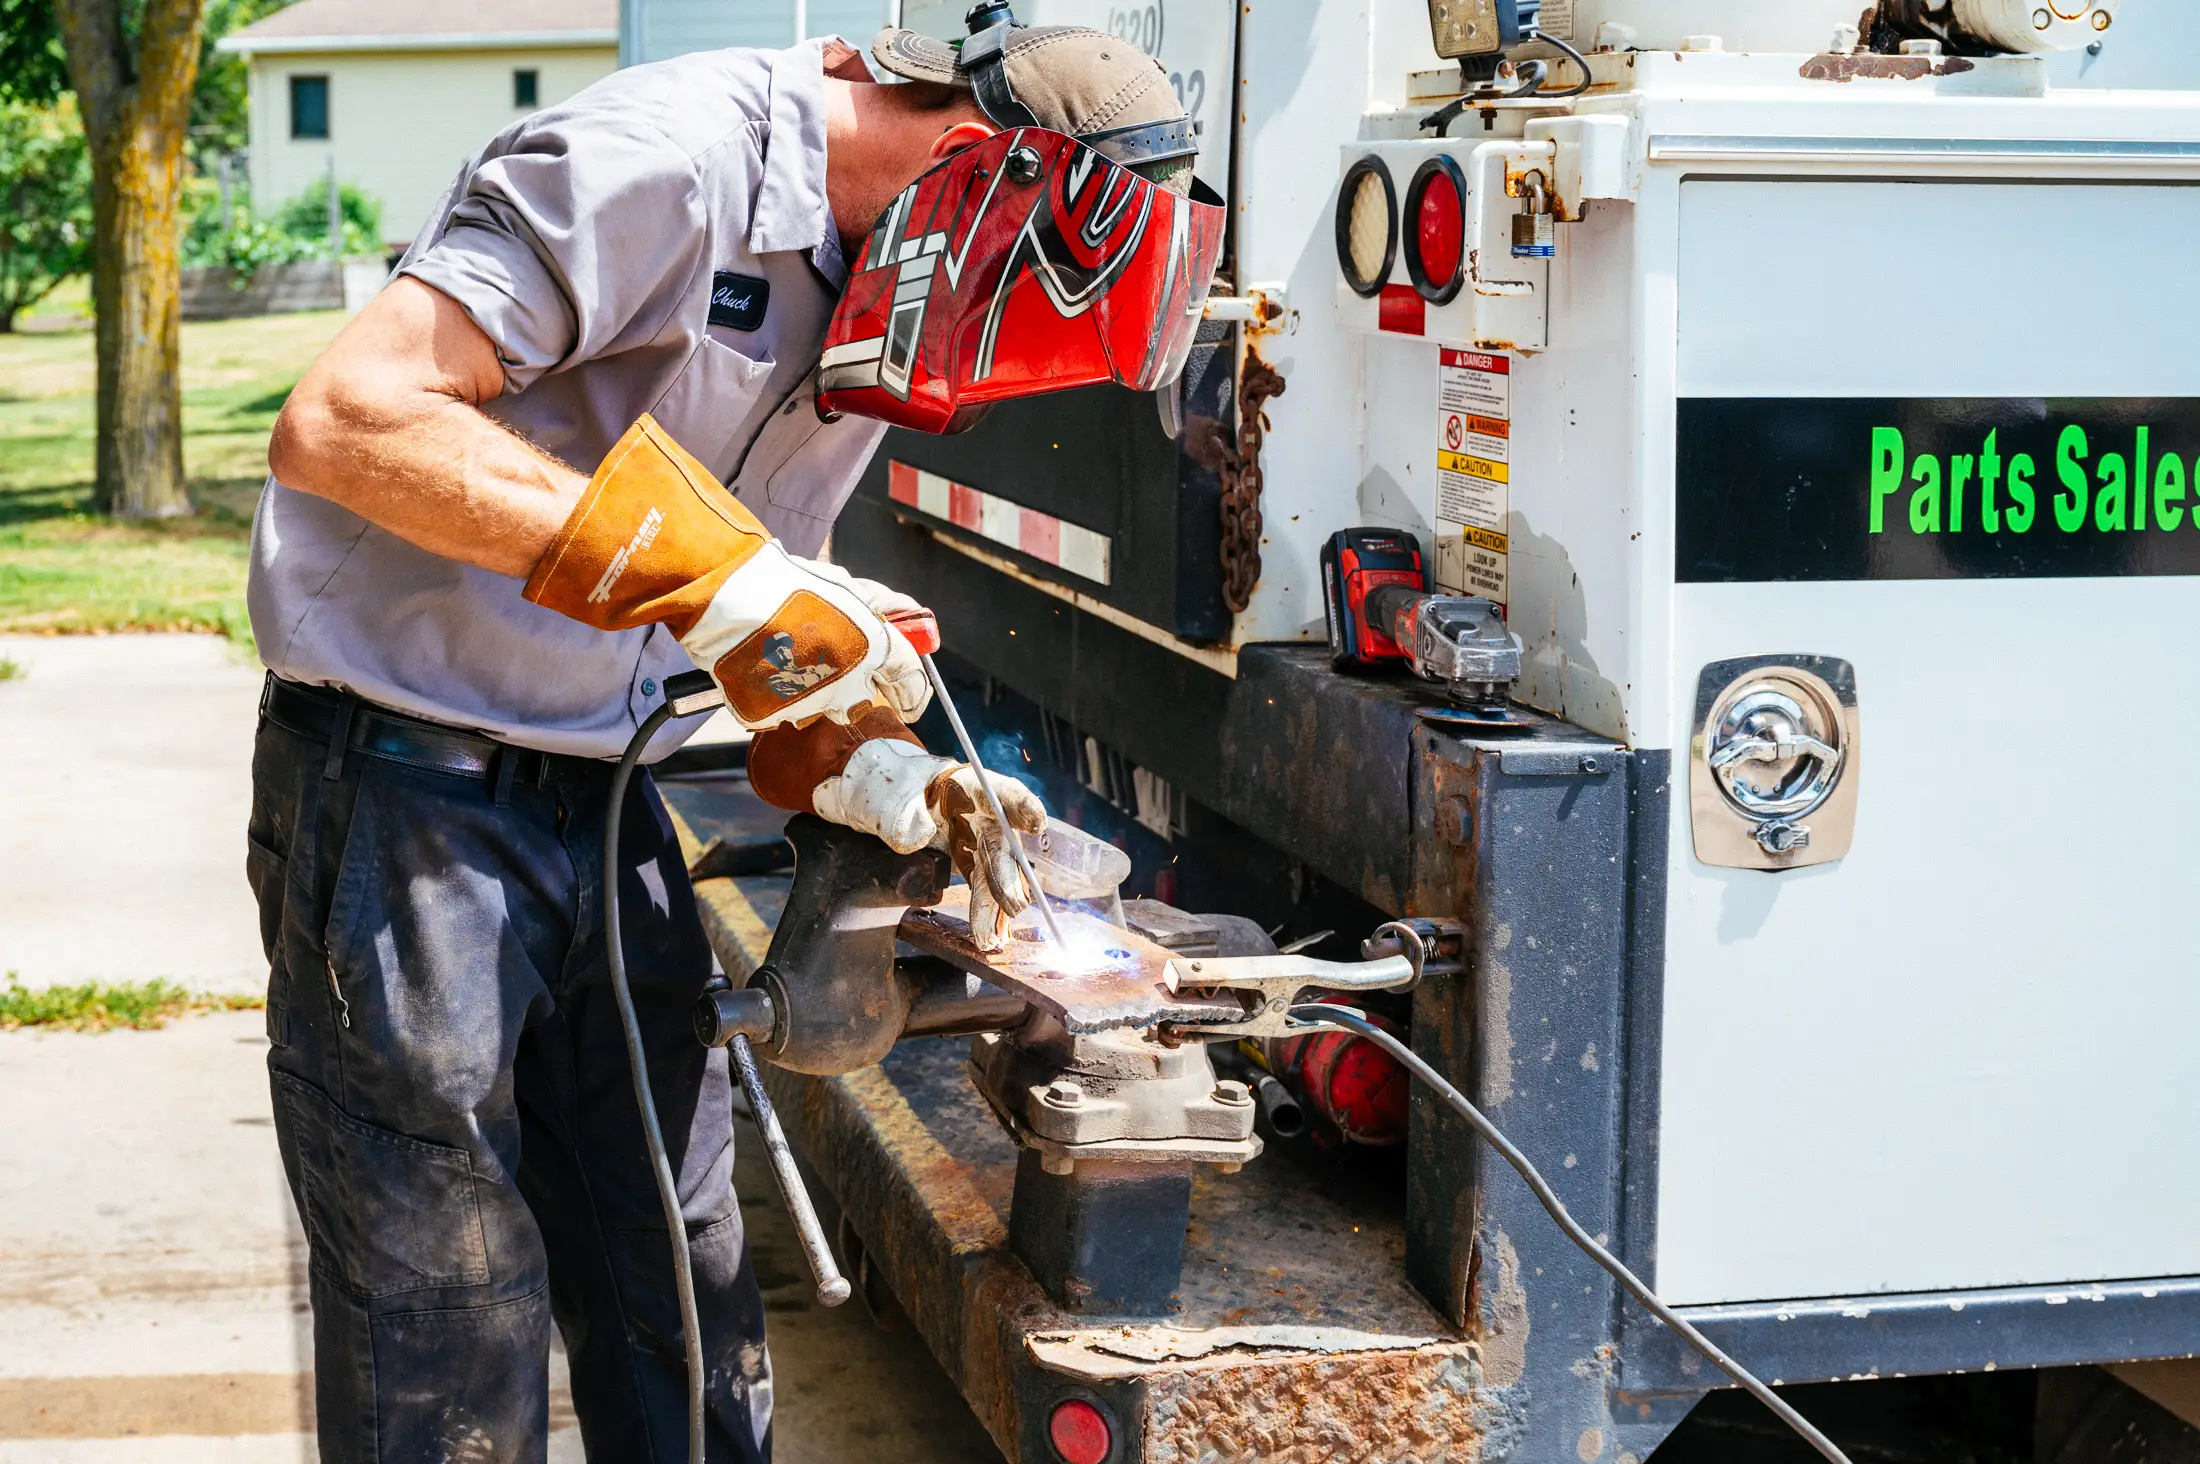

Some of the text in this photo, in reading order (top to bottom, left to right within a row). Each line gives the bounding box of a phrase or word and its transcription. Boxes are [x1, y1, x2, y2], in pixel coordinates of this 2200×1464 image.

[712, 286, 751, 311] Chuck
[1463, 353, 1493, 369] DANGER
[1476, 419, 1505, 435] WARNING
[1460, 457, 1492, 476] CAUTION
[1869, 424, 2200, 534] Parts Sale
[1474, 531, 1505, 550] CAUTION
[1473, 552, 1497, 567] LOOK UP
[1466, 564, 1504, 581] POWER LINES MAY
[1477, 578, 1500, 592] OVERHEAD
